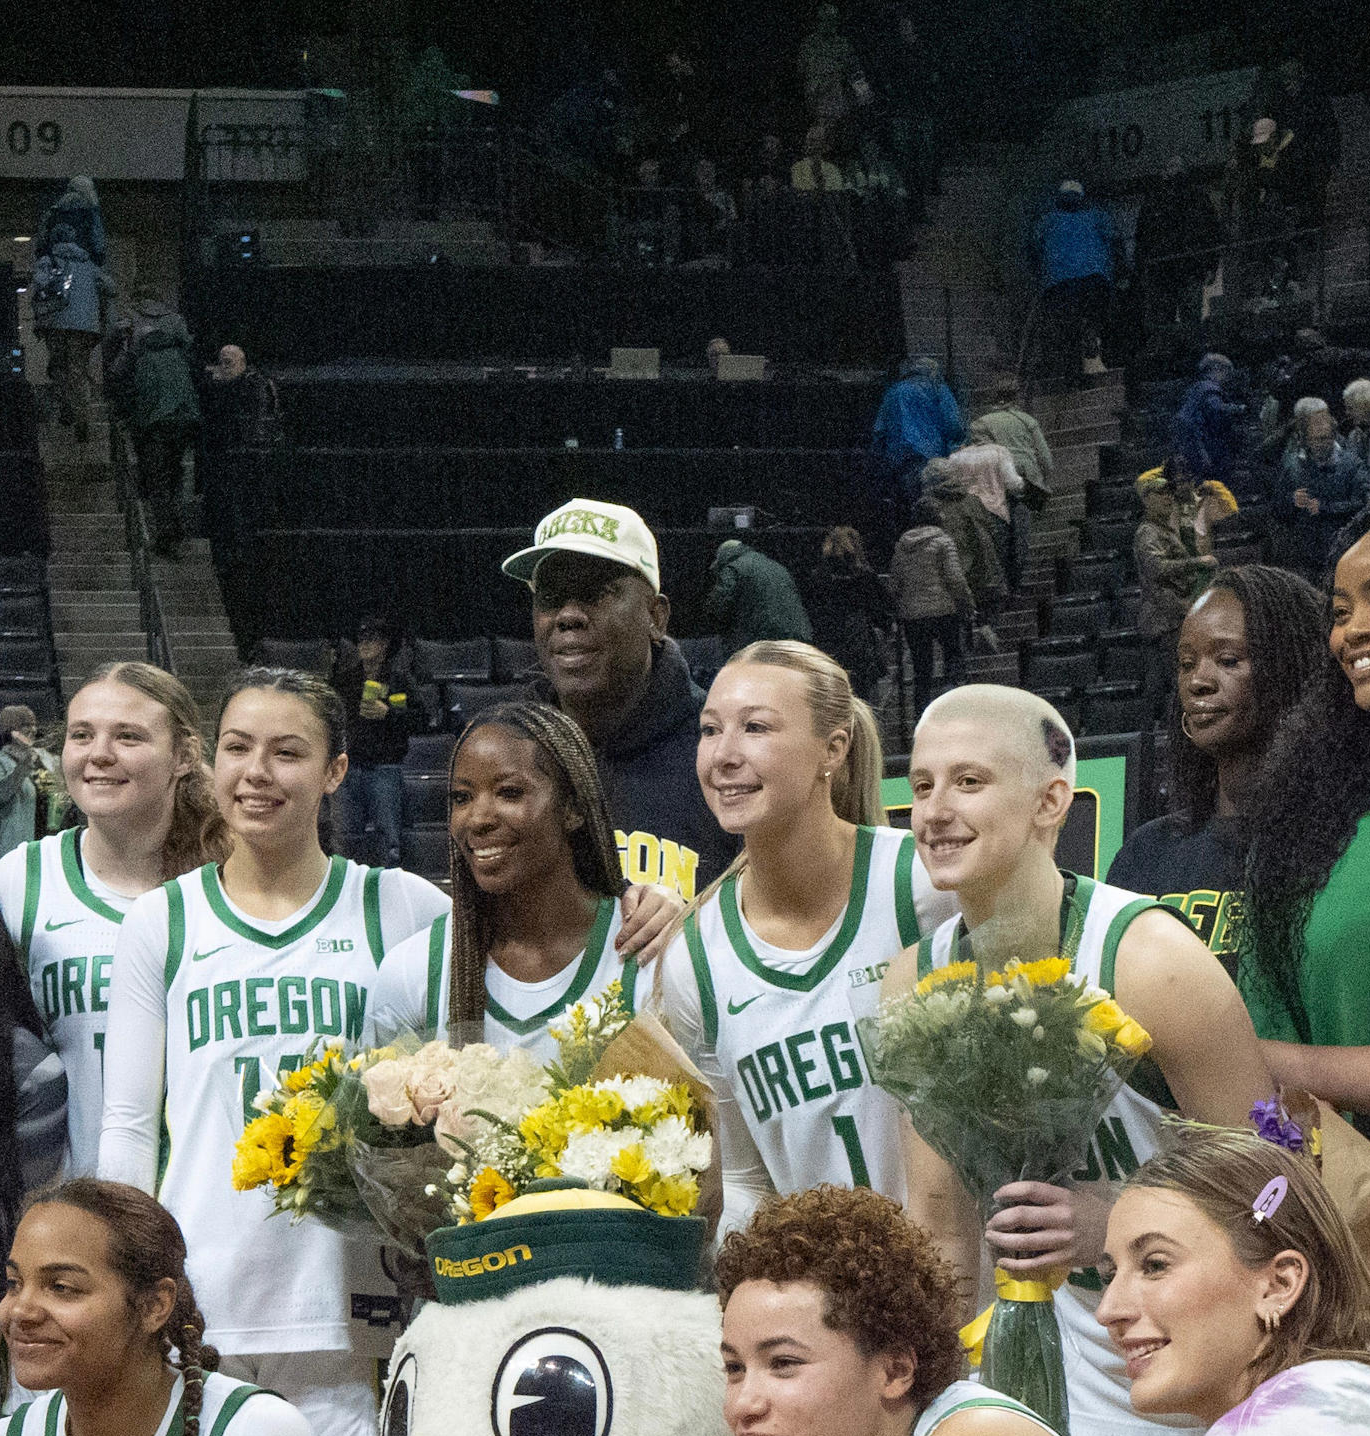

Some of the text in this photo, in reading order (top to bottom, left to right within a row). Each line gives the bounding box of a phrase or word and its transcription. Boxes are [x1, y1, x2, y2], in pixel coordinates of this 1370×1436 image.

[186, 976, 367, 1054] OREGON
[737, 1021, 877, 1124] OREG
[831, 1115, 872, 1190] 1
